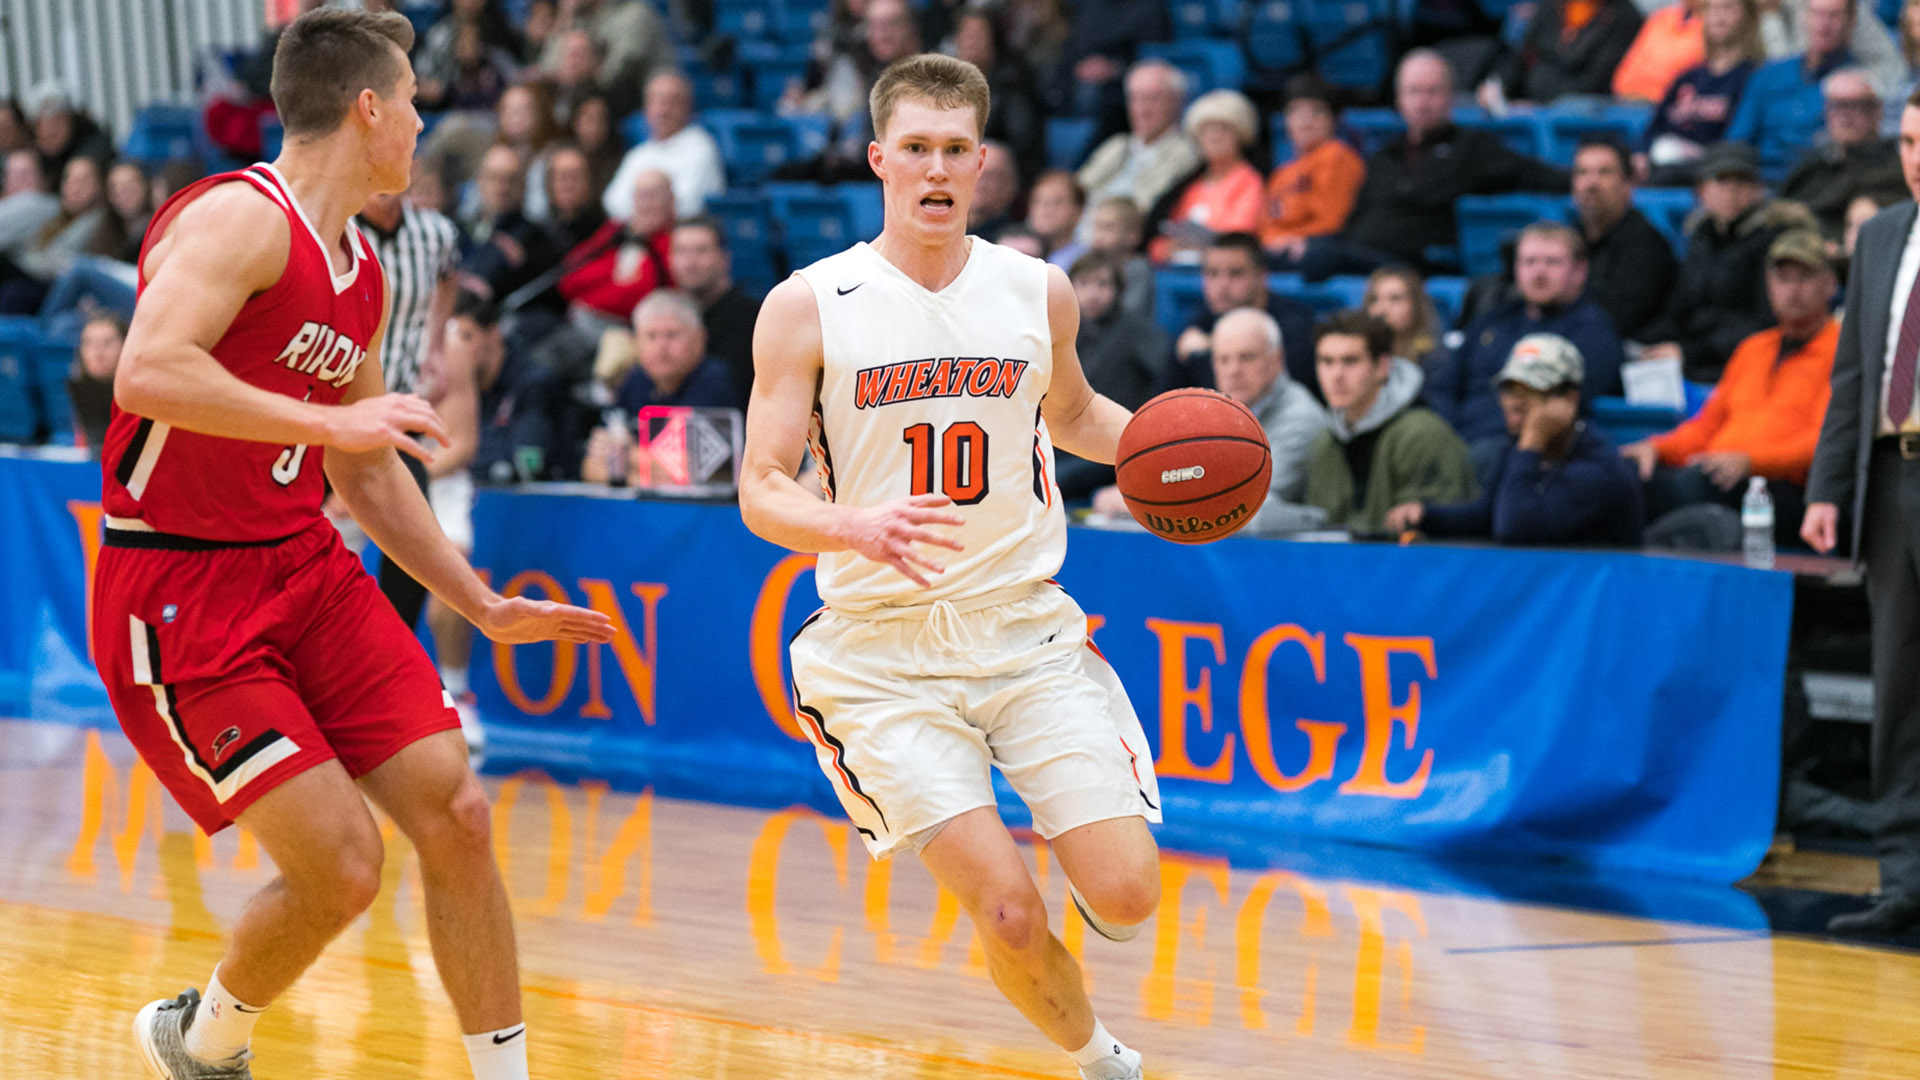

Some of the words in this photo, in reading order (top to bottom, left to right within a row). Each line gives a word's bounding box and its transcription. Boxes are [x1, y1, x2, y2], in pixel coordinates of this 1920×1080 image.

[854, 356, 1029, 410] WHEATON
[903, 420, 989, 506] 10
[1144, 503, 1248, 535] Wilson
